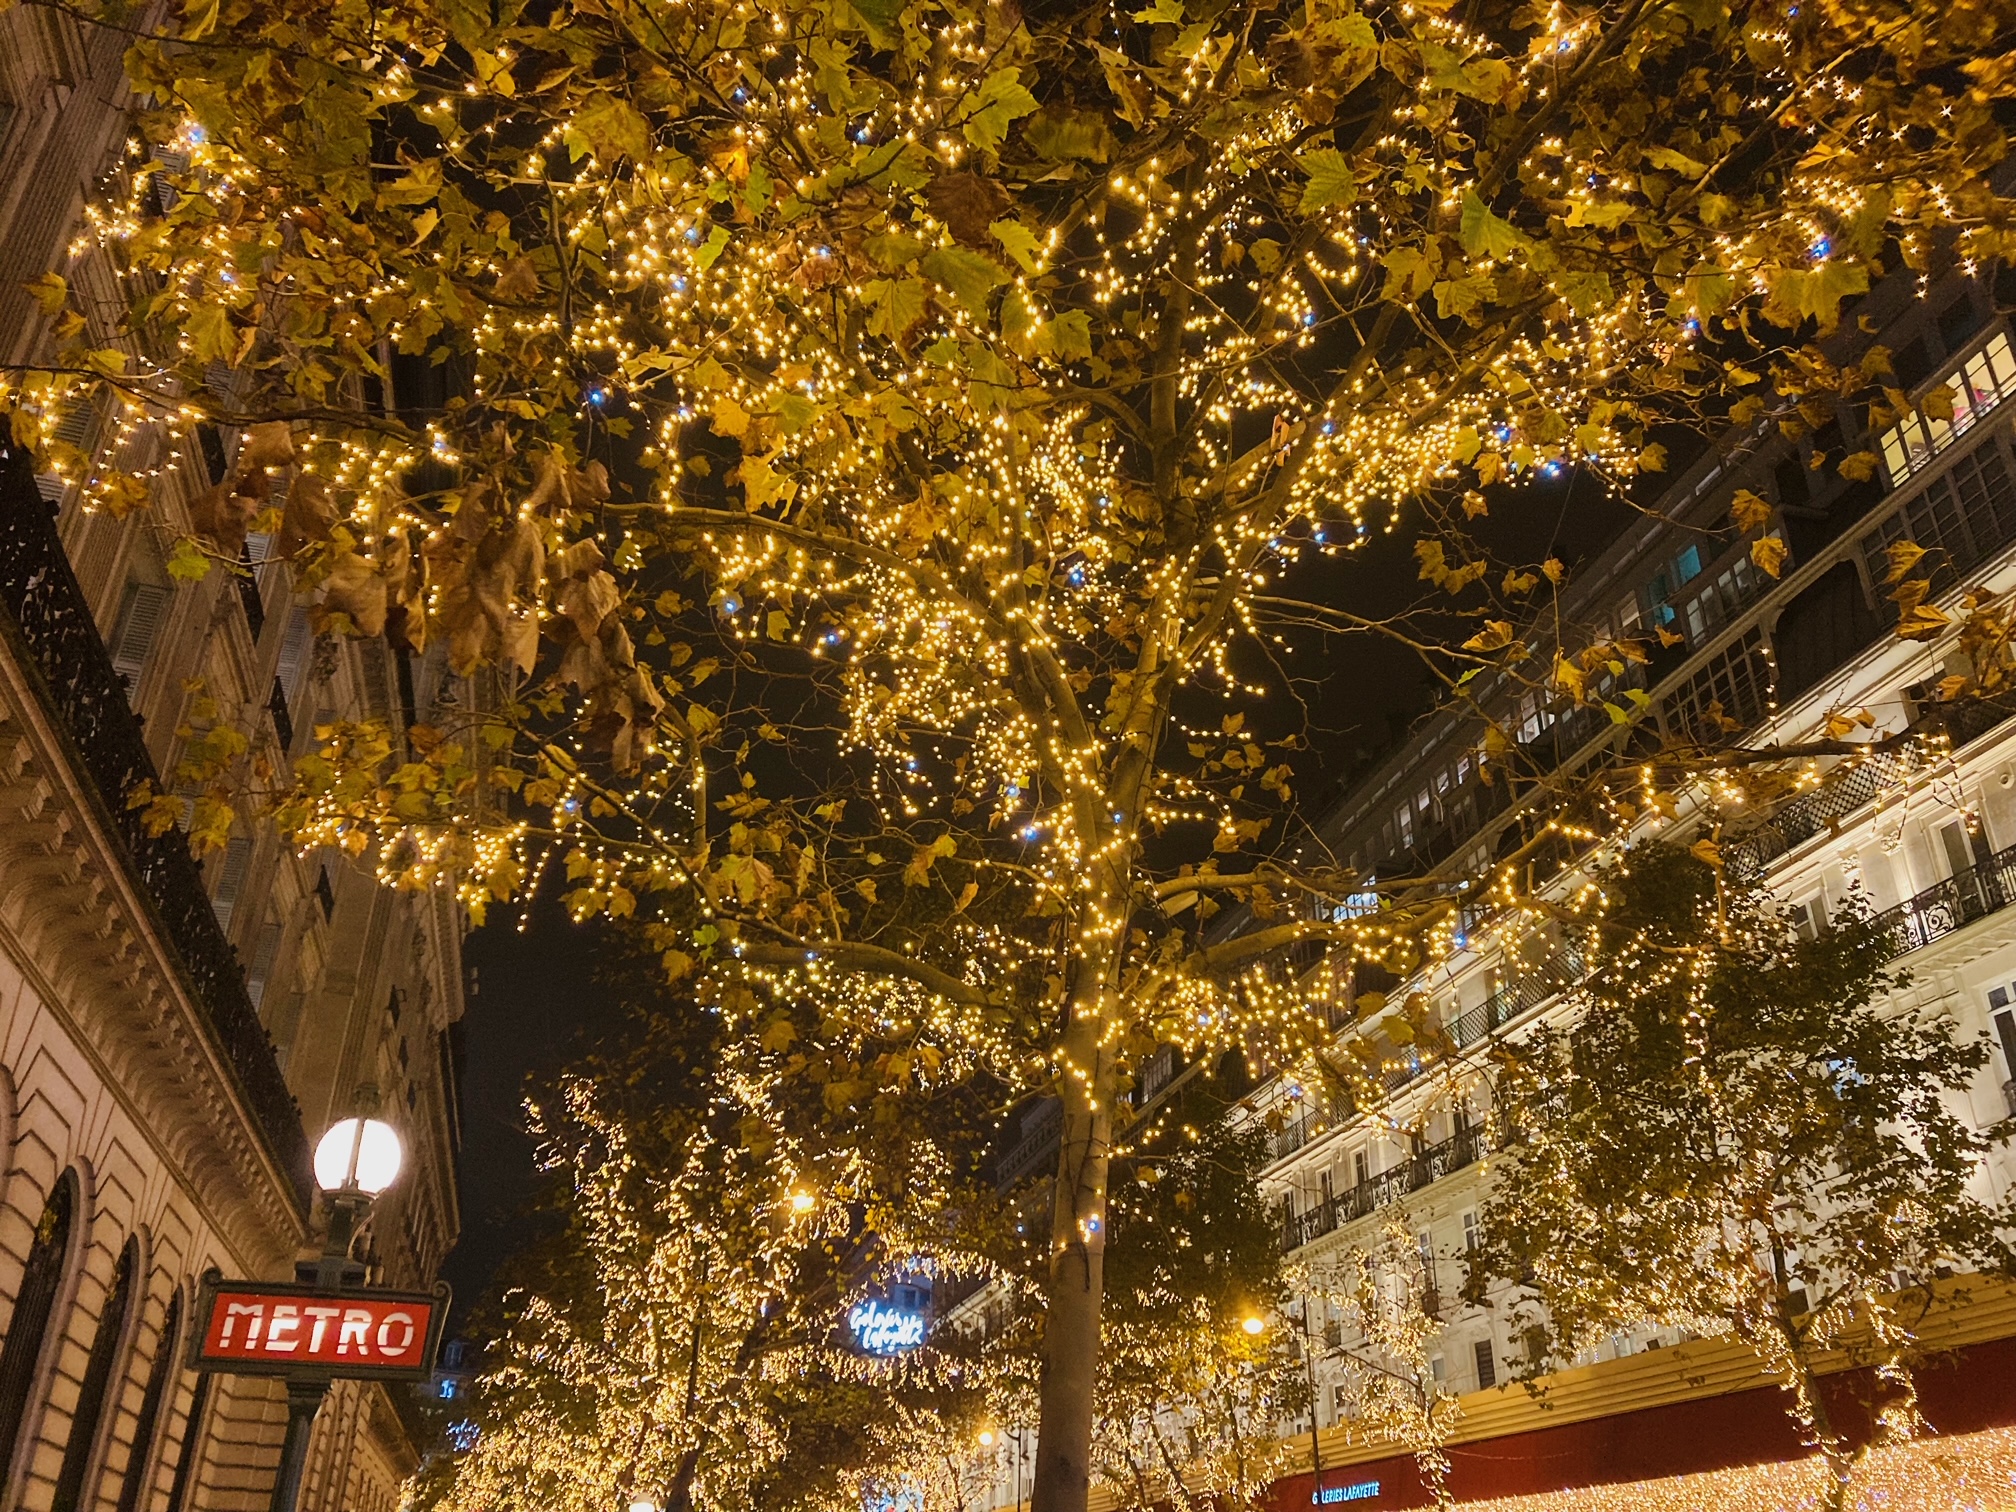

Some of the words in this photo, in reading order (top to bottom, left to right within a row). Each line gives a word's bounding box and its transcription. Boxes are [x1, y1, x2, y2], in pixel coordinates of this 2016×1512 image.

[219, 1303, 414, 1356] METRO
[1312, 1488, 1342, 1504] GLERIES
[1344, 1481, 1380, 1500] LAFAYETTE
